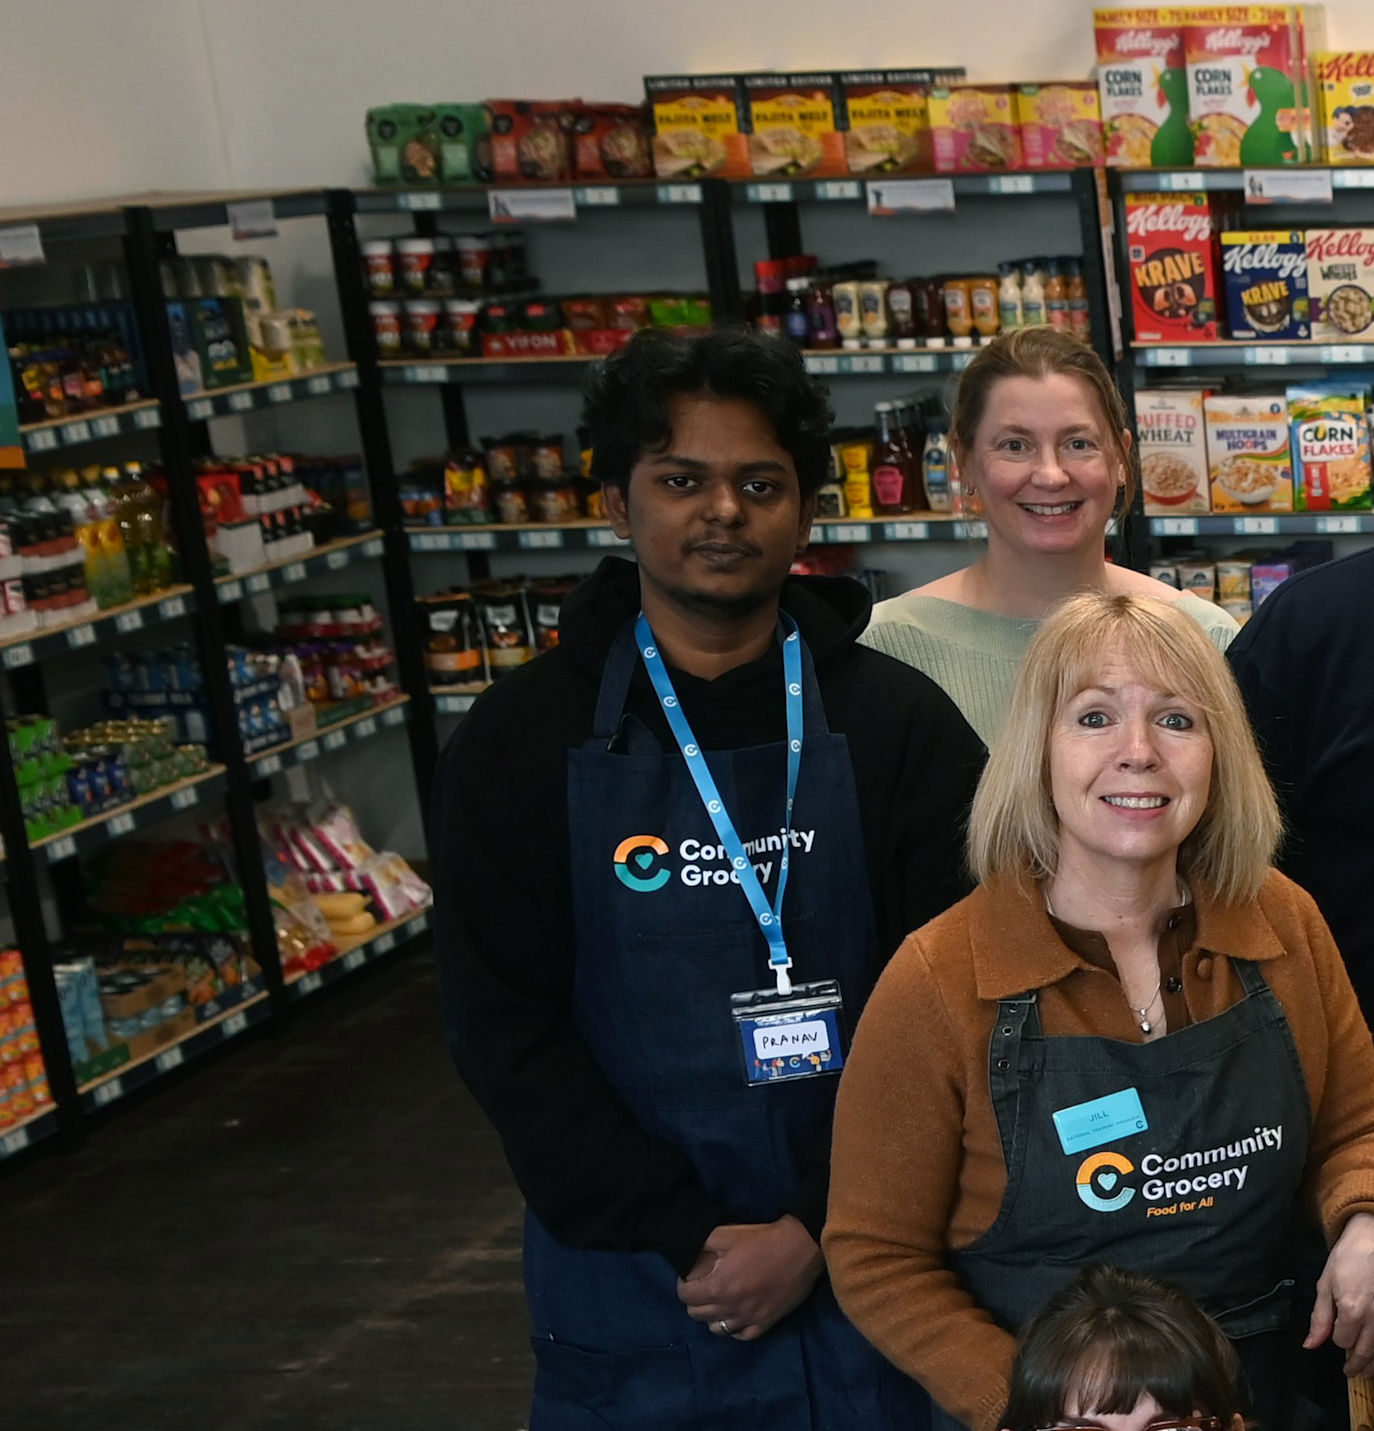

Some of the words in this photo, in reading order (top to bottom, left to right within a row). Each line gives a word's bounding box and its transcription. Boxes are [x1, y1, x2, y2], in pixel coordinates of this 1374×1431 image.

[1105, 69, 1142, 84] CORN
[1195, 68, 1232, 83] CORN
[1134, 252, 1205, 289] KRAVE
[1241, 279, 1290, 306] KRAVE
[1215, 428, 1277, 441] MULTIGRAIN
[1302, 423, 1353, 443] CORN
[1226, 439, 1268, 452] HOOPS
[1303, 442, 1356, 458] FLAKES
[680, 861, 773, 887] Grocry
[762, 1032, 818, 1050] PRANAV
[1089, 1110, 1109, 1122] JILL
[1140, 1124, 1283, 1176] Community
[1141, 1164, 1249, 1201] Grocery
[1146, 1203, 1177, 1218] Food
[1179, 1200, 1196, 1213] for
[1198, 1196, 1214, 1209] All
